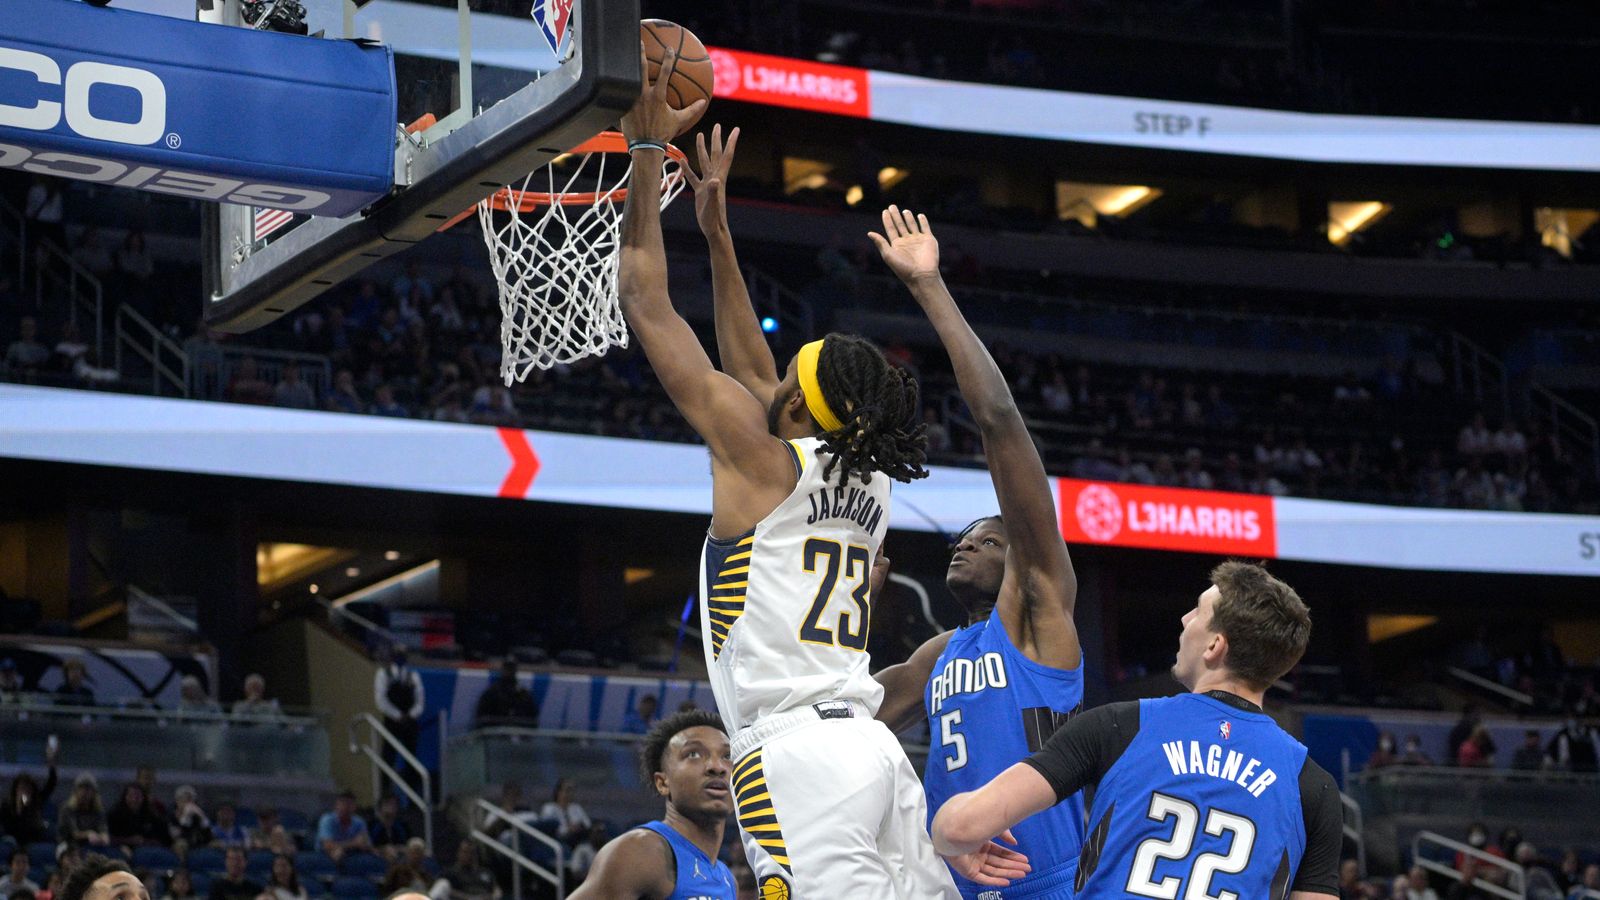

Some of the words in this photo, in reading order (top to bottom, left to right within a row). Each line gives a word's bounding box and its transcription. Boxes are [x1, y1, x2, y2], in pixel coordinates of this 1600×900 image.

[743, 65, 858, 104] L3HARRIS
[1133, 111, 1193, 136] STEP
[807, 485, 884, 537] JACKSON
[1127, 500, 1261, 541] L3HARRIS
[1579, 531, 1600, 560] S
[798, 536, 871, 653] 23
[940, 708, 968, 772] 5
[1162, 740, 1278, 798] WAGNER
[1125, 790, 1257, 900] 22
